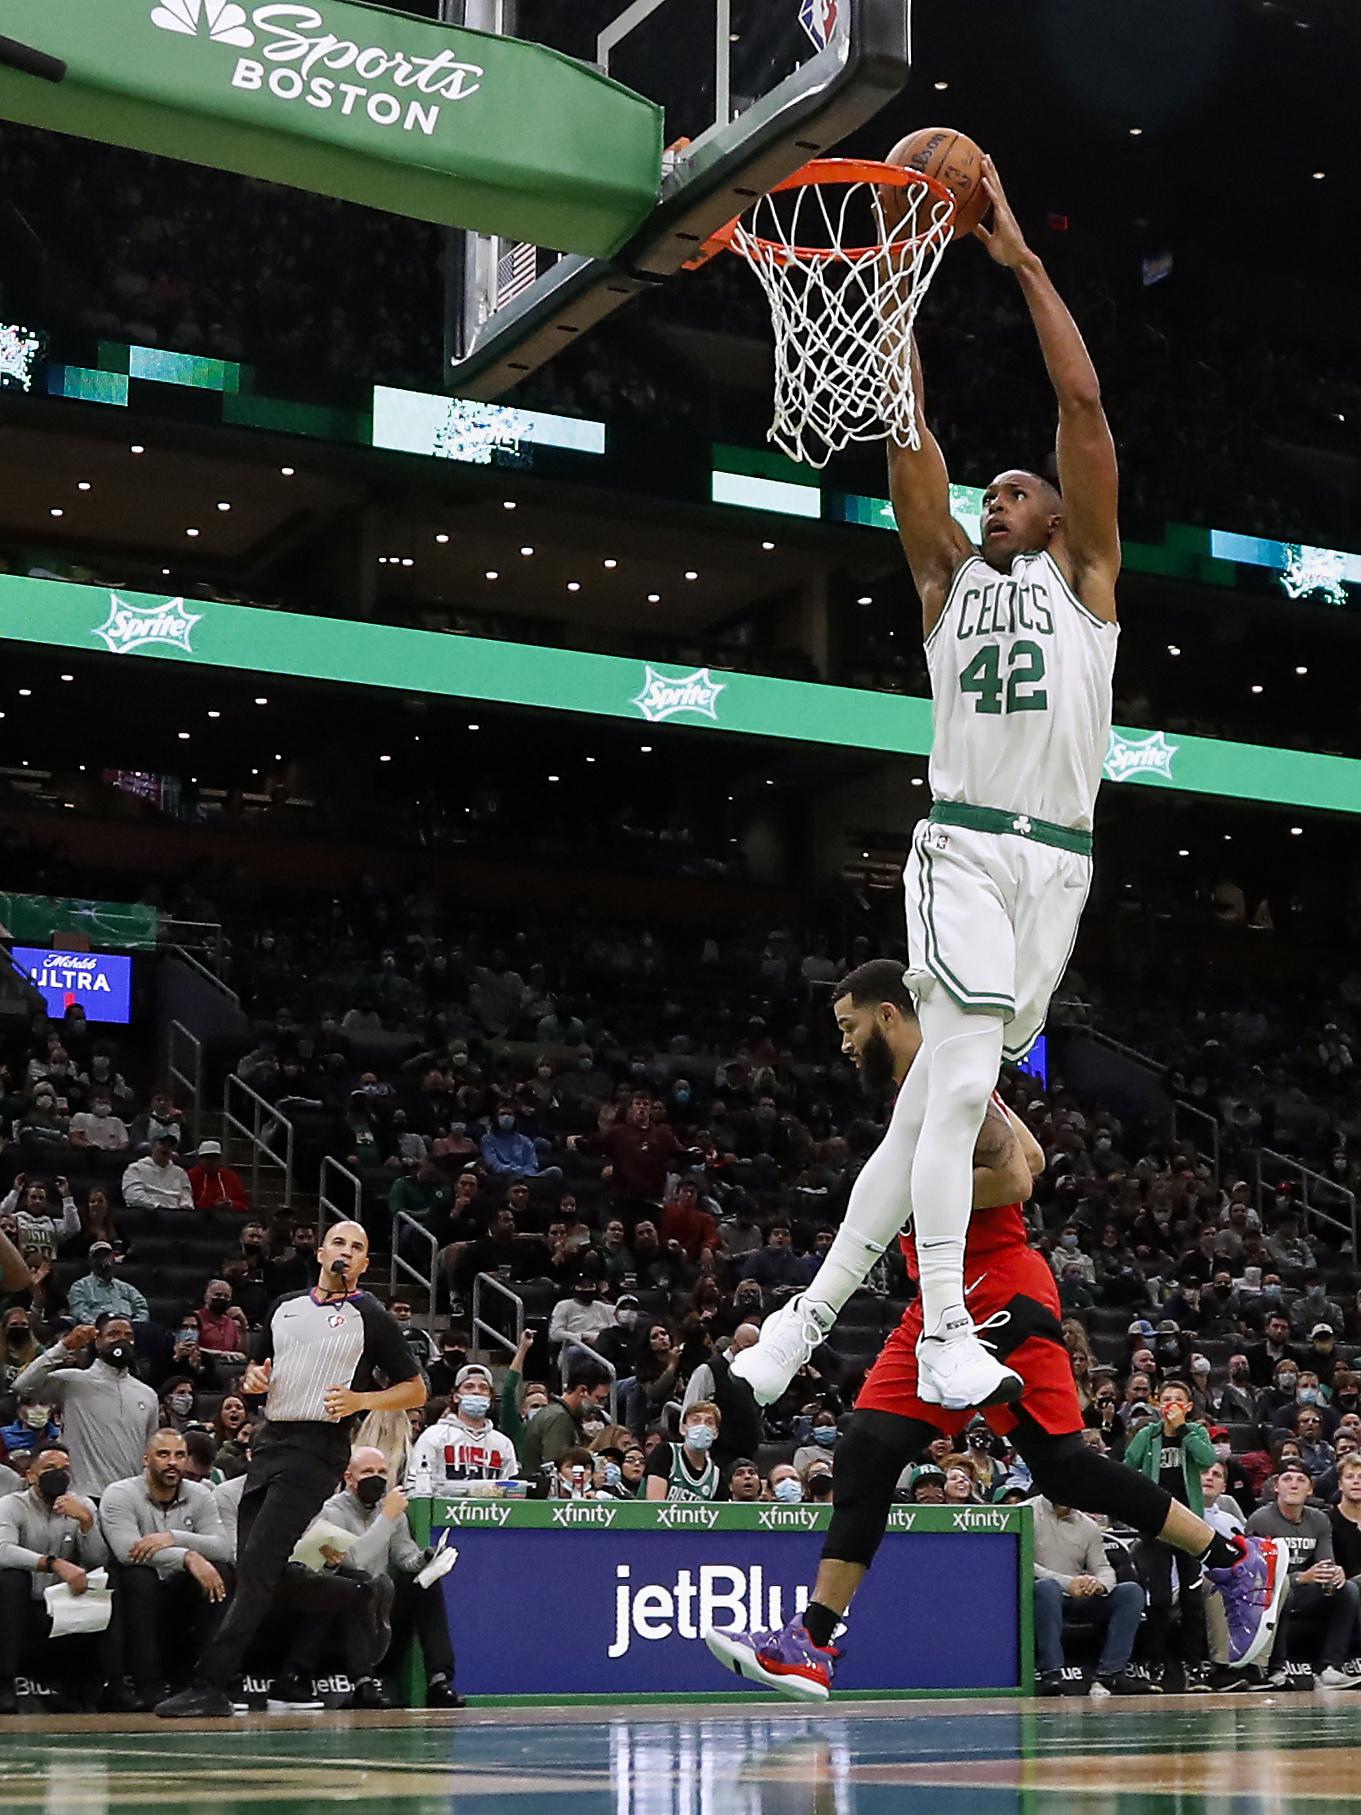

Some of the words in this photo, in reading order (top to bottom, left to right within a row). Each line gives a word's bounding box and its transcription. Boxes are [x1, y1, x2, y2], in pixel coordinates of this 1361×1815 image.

[252, 4, 484, 100] Sports
[231, 57, 440, 135] BOSTON
[108, 610, 186, 642] Sprite
[959, 640, 1048, 715] 42
[644, 681, 712, 710] Sprite
[1108, 743, 1168, 771] Sprite
[31, 968, 111, 992] ULTRA
[445, 1501, 512, 1526] xfinity
[552, 1503, 617, 1527] xfinity
[657, 1504, 719, 1528] xfinity
[758, 1506, 819, 1529] xfinity
[953, 1510, 1010, 1530] xfinity
[608, 1565, 849, 1658] jetBlu
